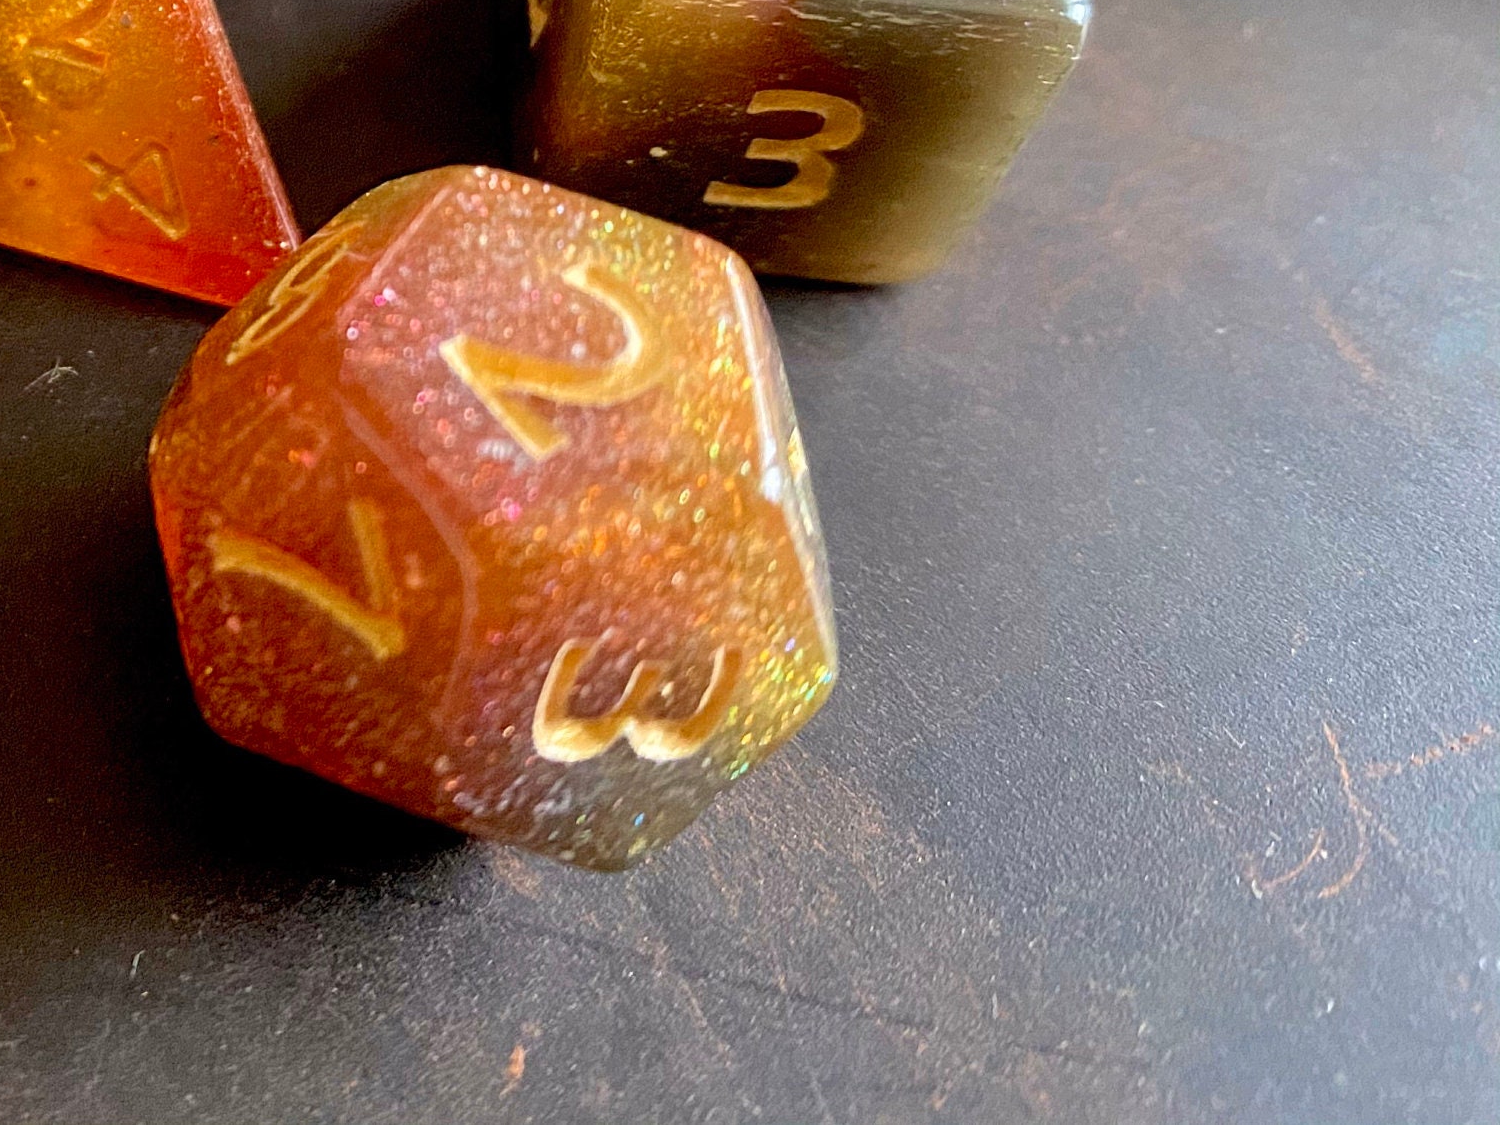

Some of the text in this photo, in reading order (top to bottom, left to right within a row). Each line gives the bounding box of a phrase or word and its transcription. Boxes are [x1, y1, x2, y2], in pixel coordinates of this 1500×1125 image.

[80, 136, 191, 242] 4
[701, 88, 866, 210] 3
[438, 255, 676, 462] 2
[206, 495, 406, 662] 7
[531, 627, 745, 764] 3
